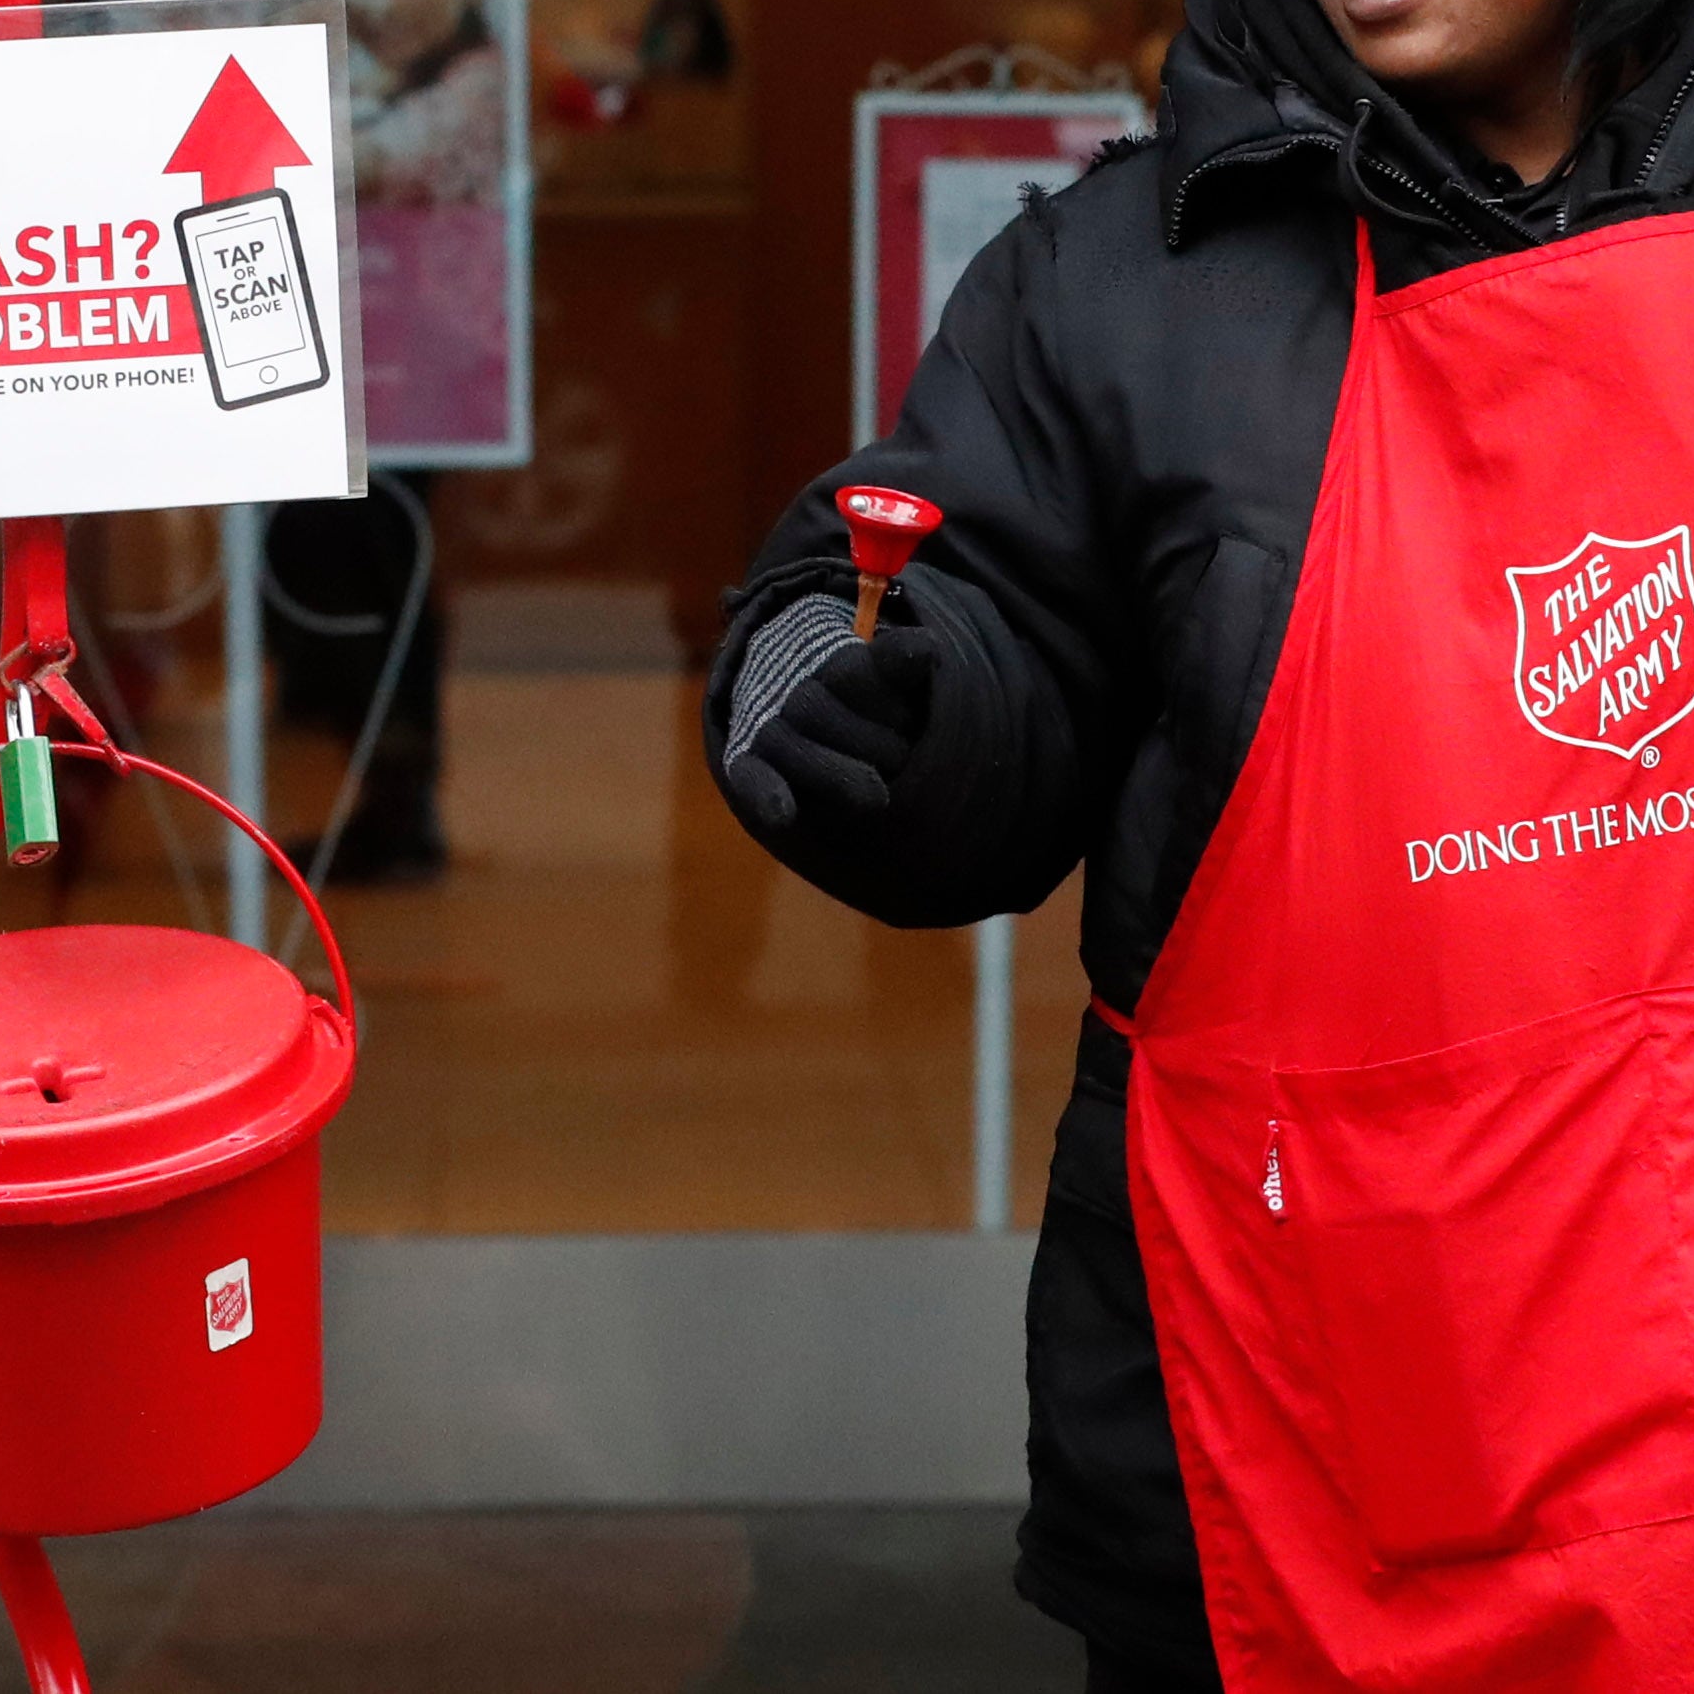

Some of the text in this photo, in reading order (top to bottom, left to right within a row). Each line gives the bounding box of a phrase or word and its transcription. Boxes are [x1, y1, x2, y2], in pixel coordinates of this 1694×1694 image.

[213, 240, 265, 269] TAP
[214, 273, 289, 309] SCAN
[234, 266, 256, 281] OR
[229, 299, 282, 322] ABOVE
[12, 377, 44, 394] ON
[51, 373, 108, 391] YOUR
[115, 368, 195, 387] PHONE!
[1544, 553, 1612, 637] THE
[1527, 548, 1684, 718] SALVATION
[1597, 614, 1684, 737] ARMY
[1405, 820, 1540, 883] DOING
[1542, 804, 1621, 857] THE
